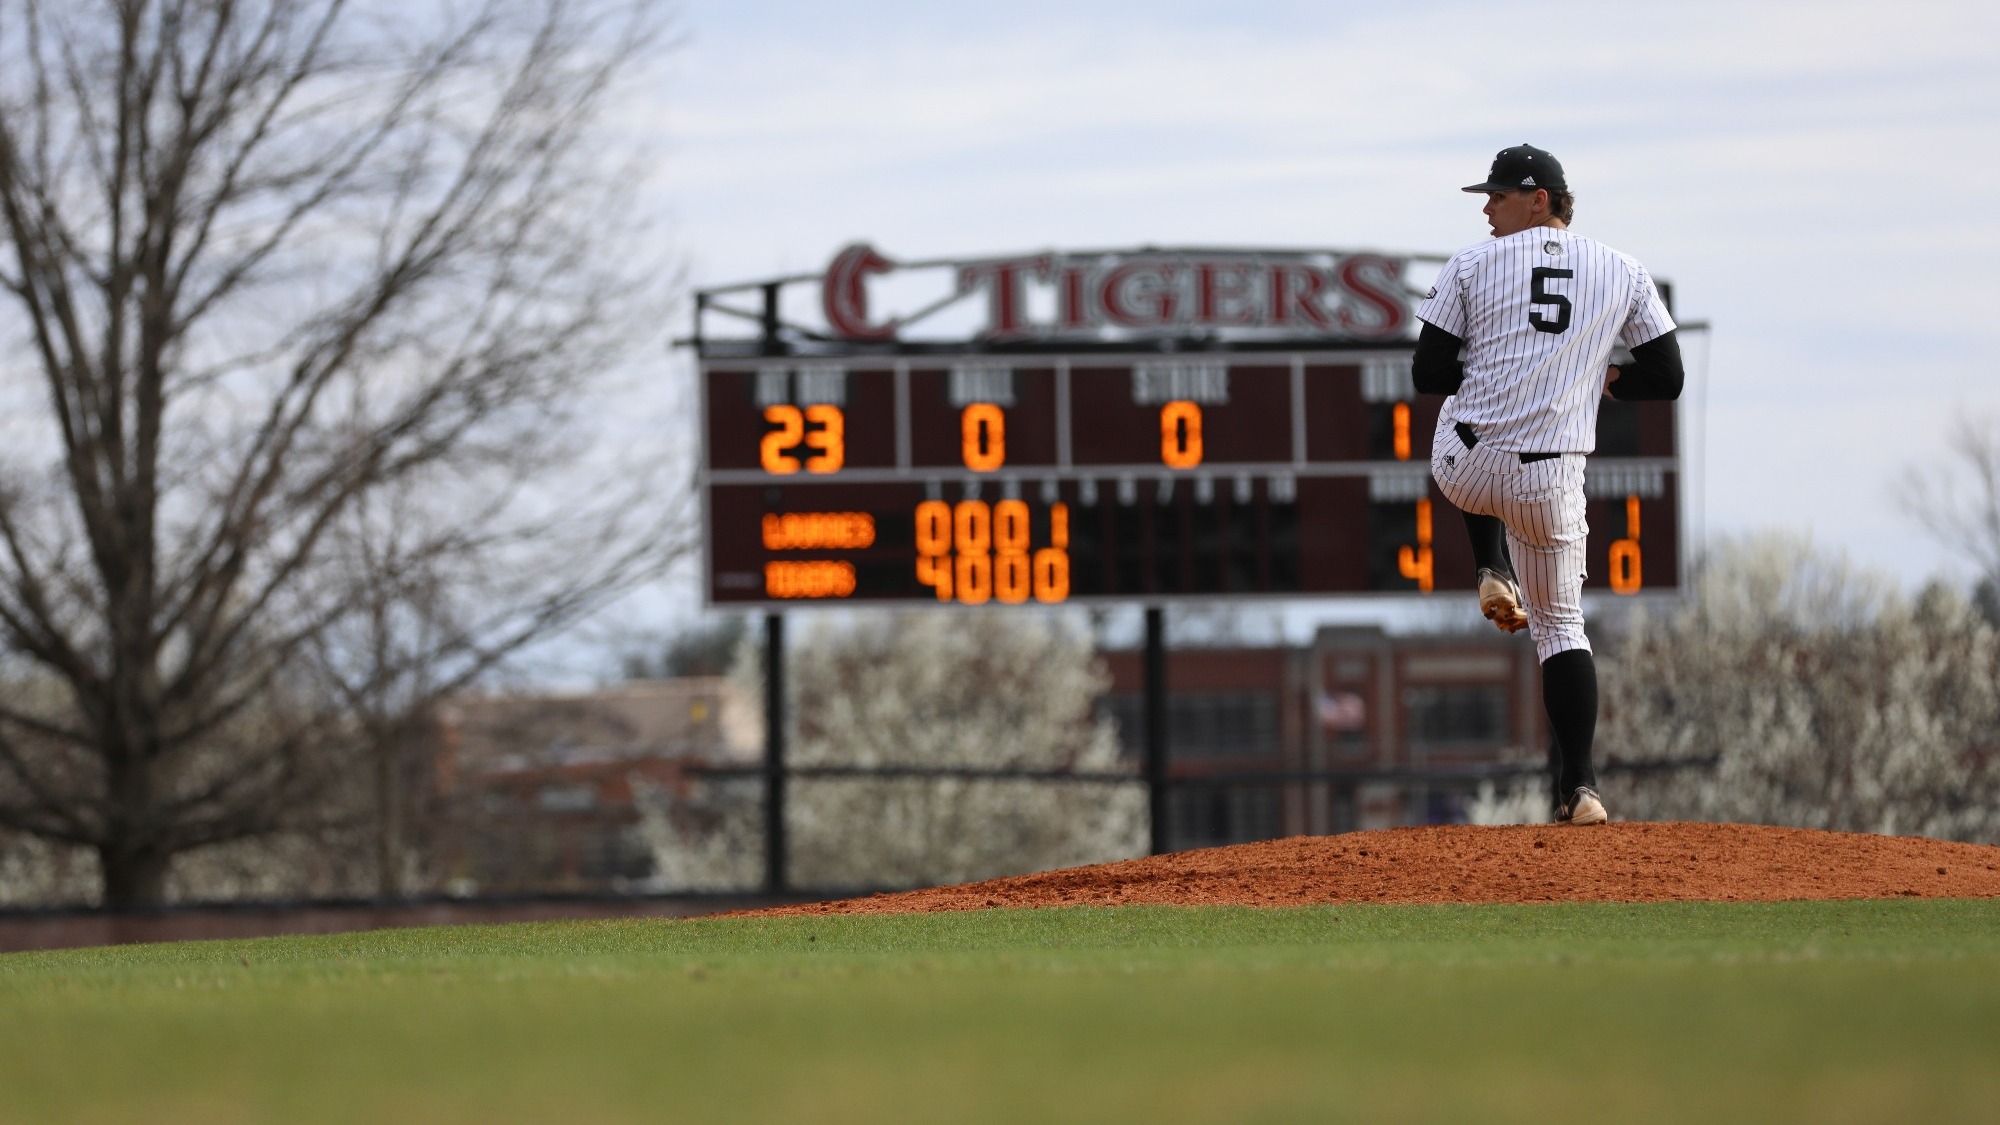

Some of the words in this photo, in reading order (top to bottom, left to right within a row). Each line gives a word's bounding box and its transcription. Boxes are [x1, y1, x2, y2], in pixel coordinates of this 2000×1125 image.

[954, 250, 1410, 341] TIGERS
[1528, 266, 1574, 335] 5
[760, 404, 845, 474] 23
[961, 403, 1006, 472] 0
[1160, 400, 1203, 469] 0
[1393, 402, 1411, 461] 1
[1416, 497, 1432, 543] 1
[1627, 494, 1641, 538] 1
[1398, 544, 1434, 593] 4
[1609, 538, 1643, 594] 0
